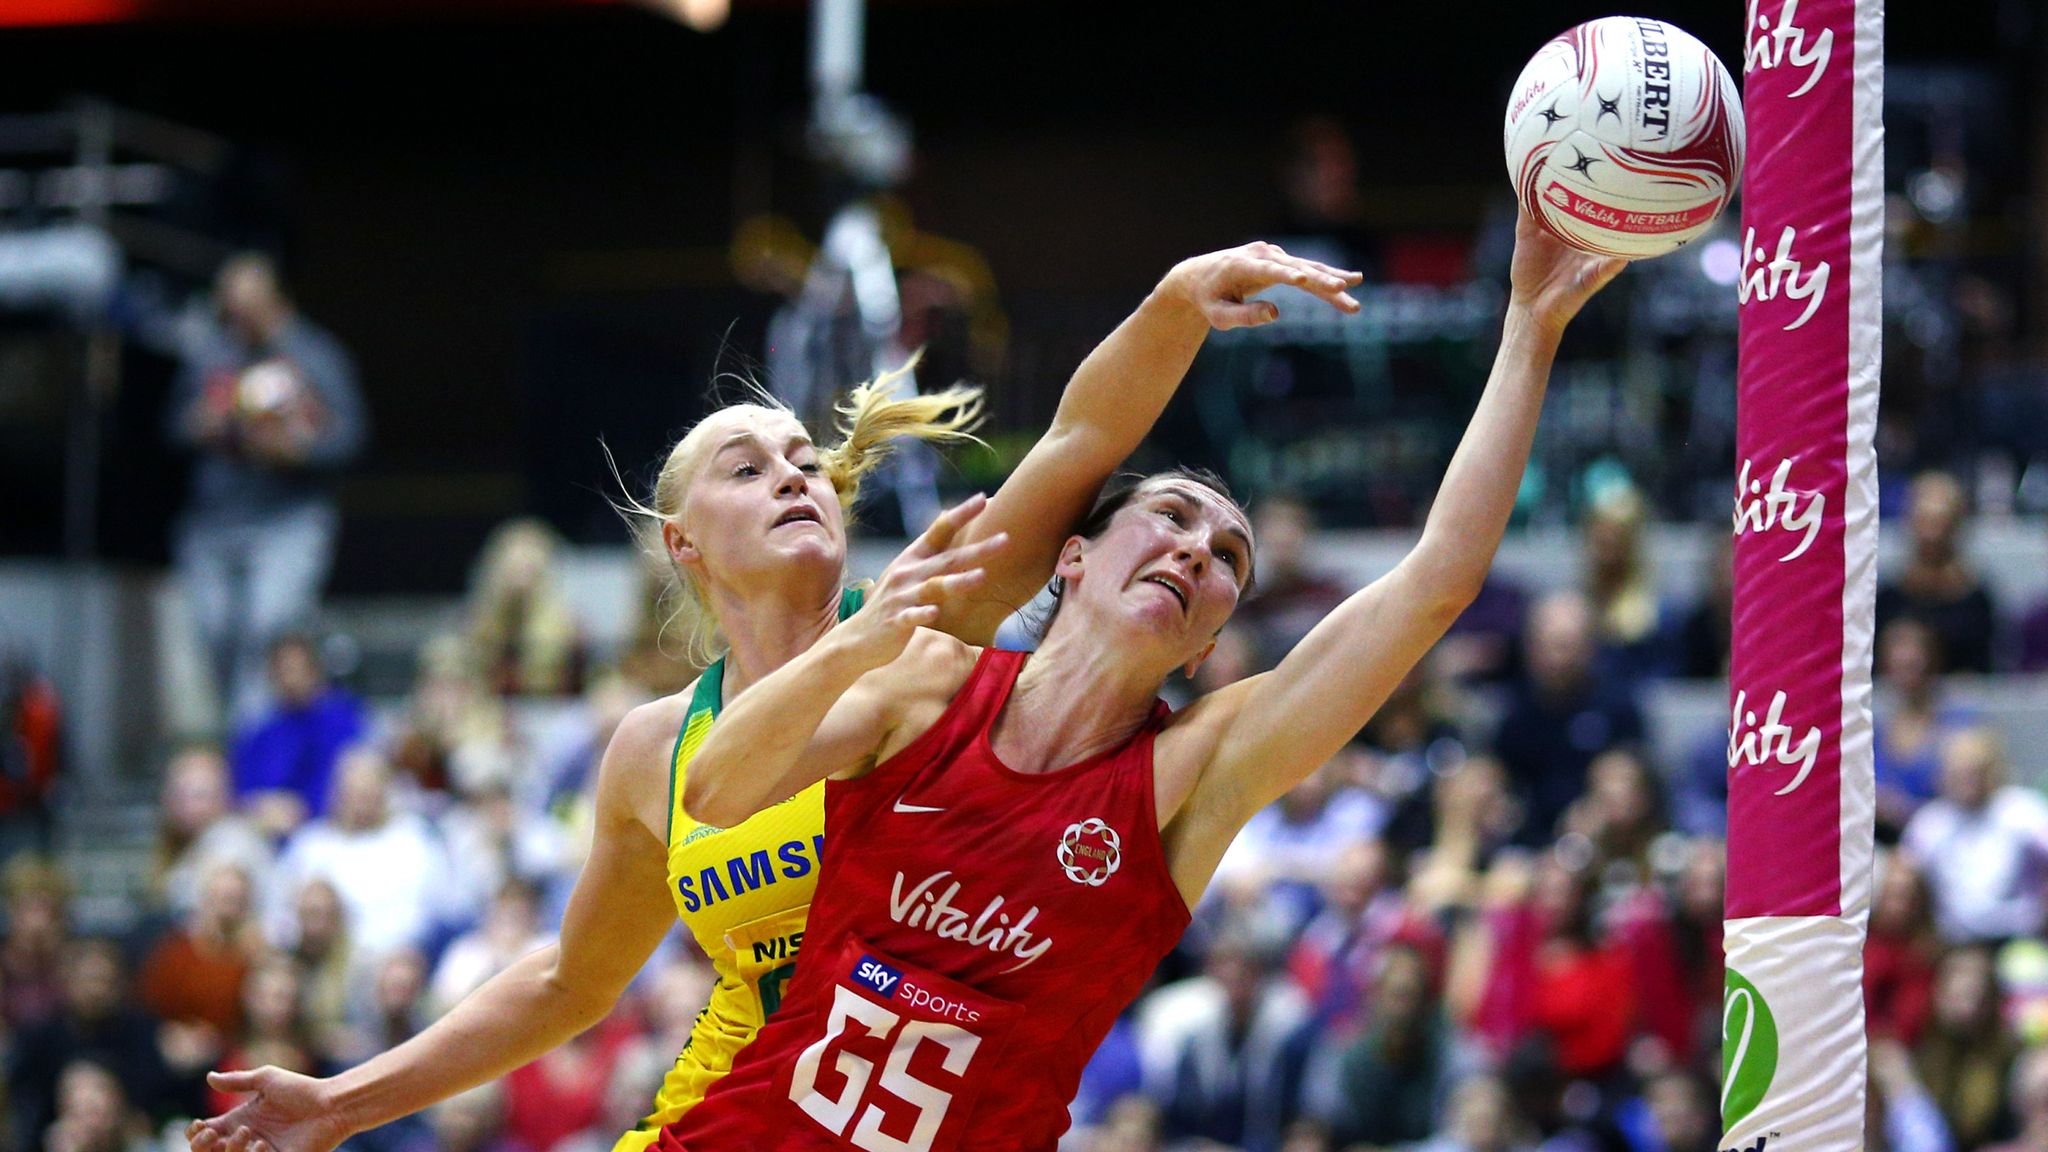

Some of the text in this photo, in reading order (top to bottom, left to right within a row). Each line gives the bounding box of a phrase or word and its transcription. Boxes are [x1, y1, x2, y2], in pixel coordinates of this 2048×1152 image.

[1636, 20, 1670, 136] ILBERT
[1744, 0, 1834, 98] lity
[1573, 199, 1619, 229] Vitality
[1625, 212, 1689, 225] NETBALL
[1738, 226, 1830, 331] lity
[1733, 458, 1826, 562] lity
[1727, 690, 1822, 796] lity
[678, 834, 824, 913] SAMS
[890, 870, 1053, 974] Vitality
[752, 931, 805, 963] NIS
[858, 962, 981, 1022] sky sports
[788, 983, 983, 1152] GS
